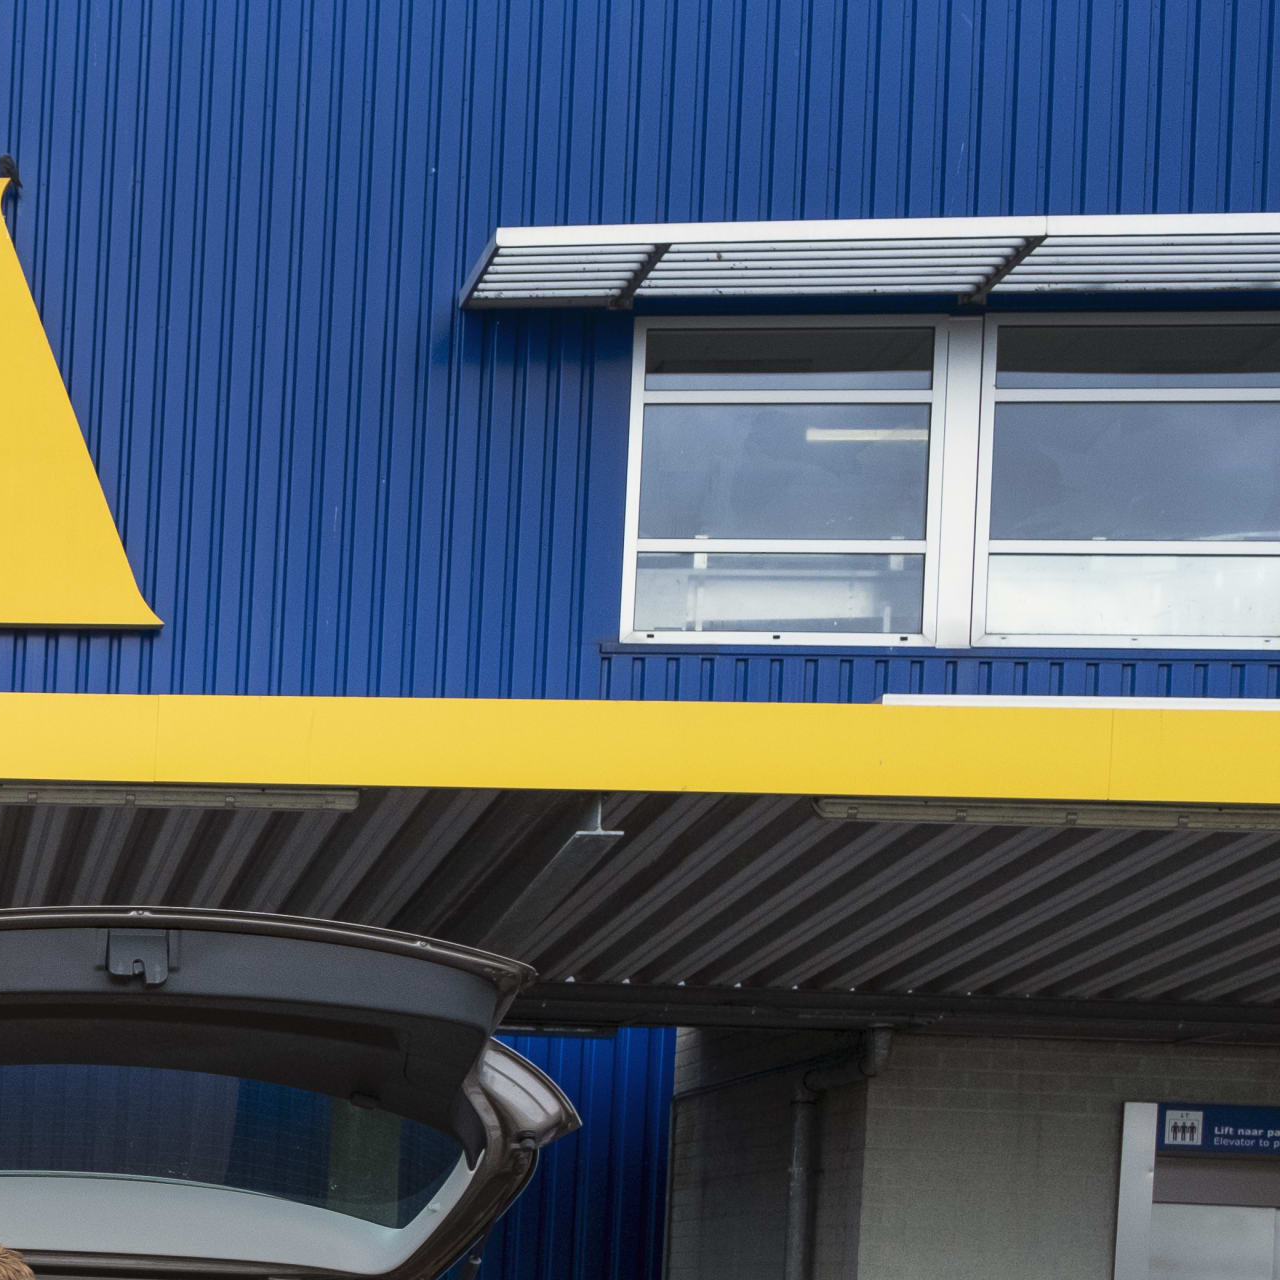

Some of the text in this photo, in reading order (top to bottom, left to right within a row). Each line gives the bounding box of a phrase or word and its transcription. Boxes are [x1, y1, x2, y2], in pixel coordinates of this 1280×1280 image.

[1214, 1126, 1233, 1135] Lift
[1237, 1128, 1264, 1136] naar
[1214, 1136, 1256, 1146] Elevator
[1259, 1138, 1270, 1147] to
